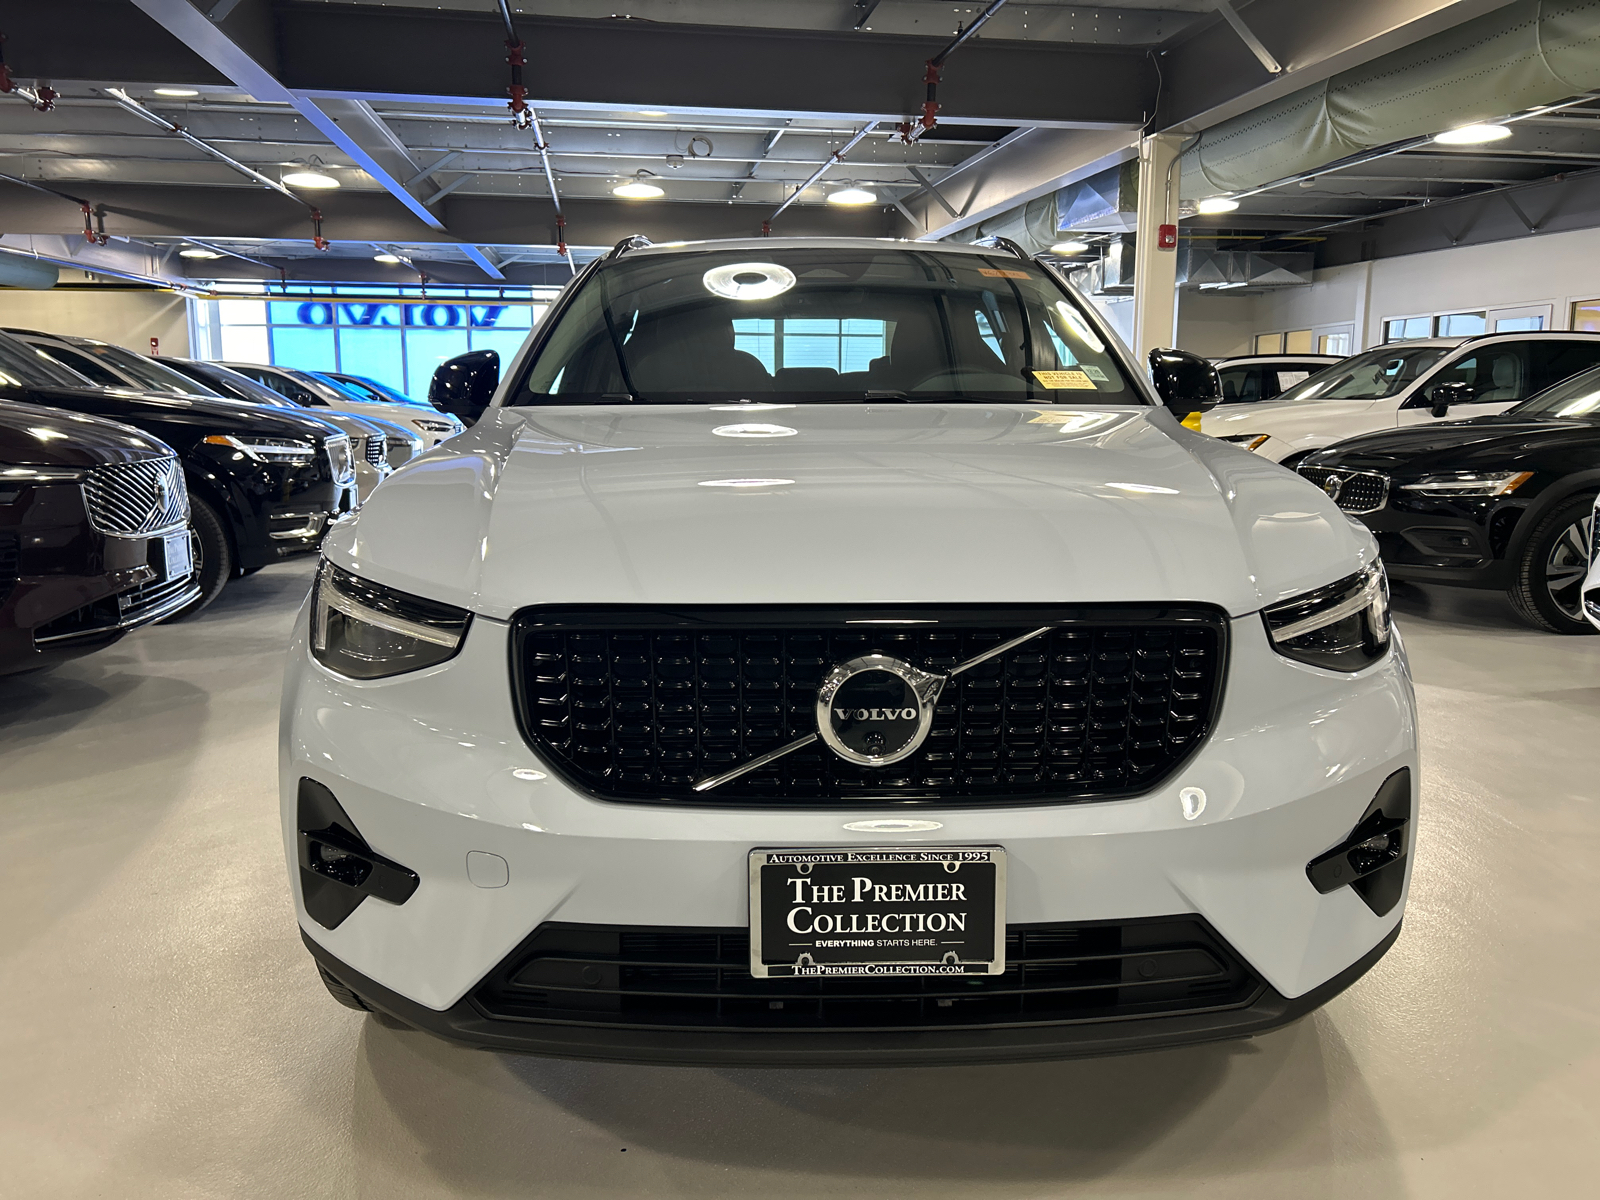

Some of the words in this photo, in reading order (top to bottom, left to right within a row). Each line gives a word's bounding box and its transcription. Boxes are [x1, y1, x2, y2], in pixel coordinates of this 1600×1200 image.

[834, 707, 917, 720] VOLVO
[769, 854, 844, 863] AUTOMOTIVE
[847, 853, 917, 862] EXCELLENCE
[919, 852, 953, 861] SINCE
[957, 852, 988, 861] 1995
[787, 877, 846, 904] THE
[851, 877, 967, 902] PREMIER
[786, 906, 967, 934] COLLECTION
[815, 940, 875, 948] EVERYTHING
[876, 939, 910, 947] STARTS
[911, 939, 938, 947] HERE.
[791, 964, 965, 975] THEPREMIERCOLLECTION.COM
